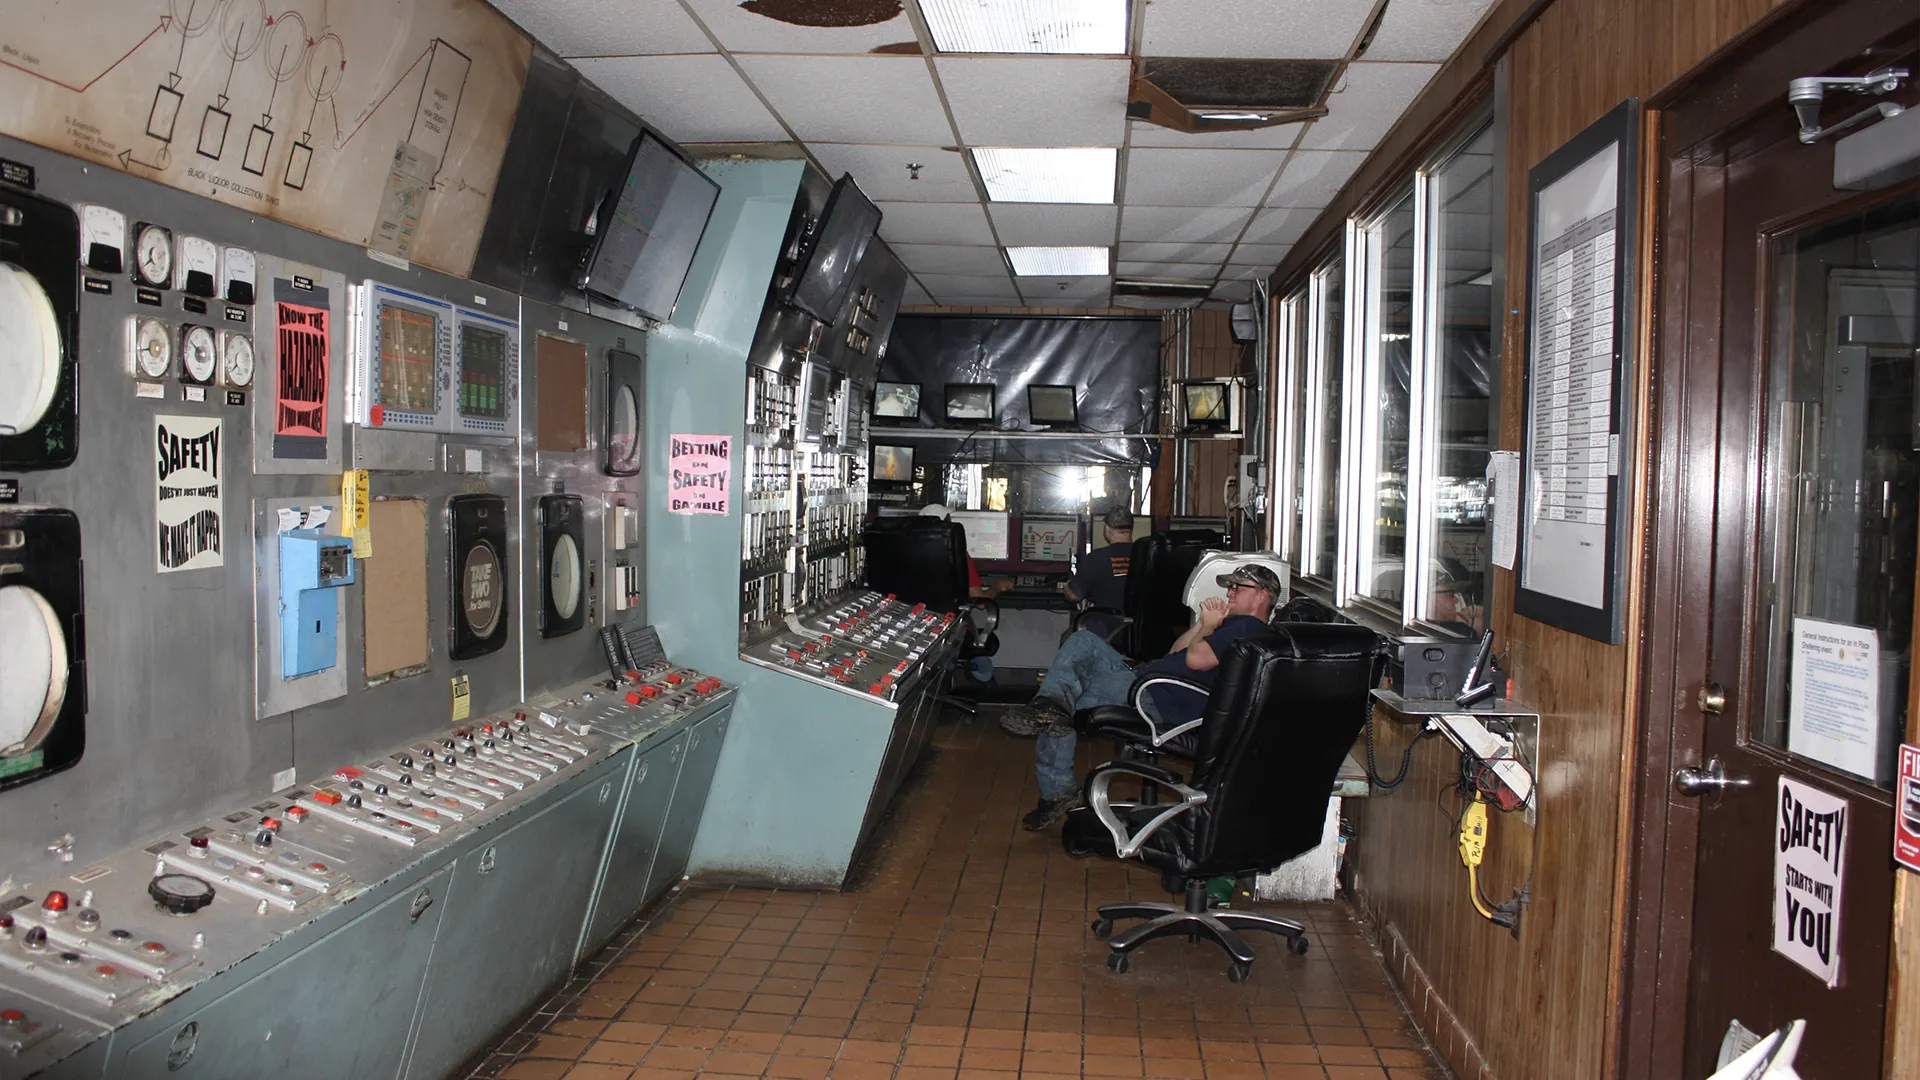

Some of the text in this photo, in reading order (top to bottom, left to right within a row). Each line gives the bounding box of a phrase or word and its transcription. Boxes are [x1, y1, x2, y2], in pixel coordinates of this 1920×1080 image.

[187, 167, 206, 181] BLACK
[208, 175, 229, 189] LIQUOR
[230, 182, 263, 201] COLLECTION
[278, 302, 325, 333] KNOW THE
[279, 328, 326, 405] HAZARDS
[158, 423, 220, 482] SAFETY
[672, 438, 728, 460] BETTING
[183, 487, 197, 497] JUST
[198, 484, 219, 499] HAPPEN
[673, 469, 727, 491] SAFETY
[158, 509, 221, 569] WE MAKE IT HAPPEN
[470, 563, 492, 582] TAKE
[471, 580, 490, 599] TWO
[1801, 630, 1818, 641] General
[1858, 640, 1870, 650] Place
[1801, 641, 1820, 654] Sheltering
[1779, 785, 1845, 878] SAFETY
[1785, 863, 1833, 910] STARTS WITH
[1785, 887, 1832, 966] YOU
